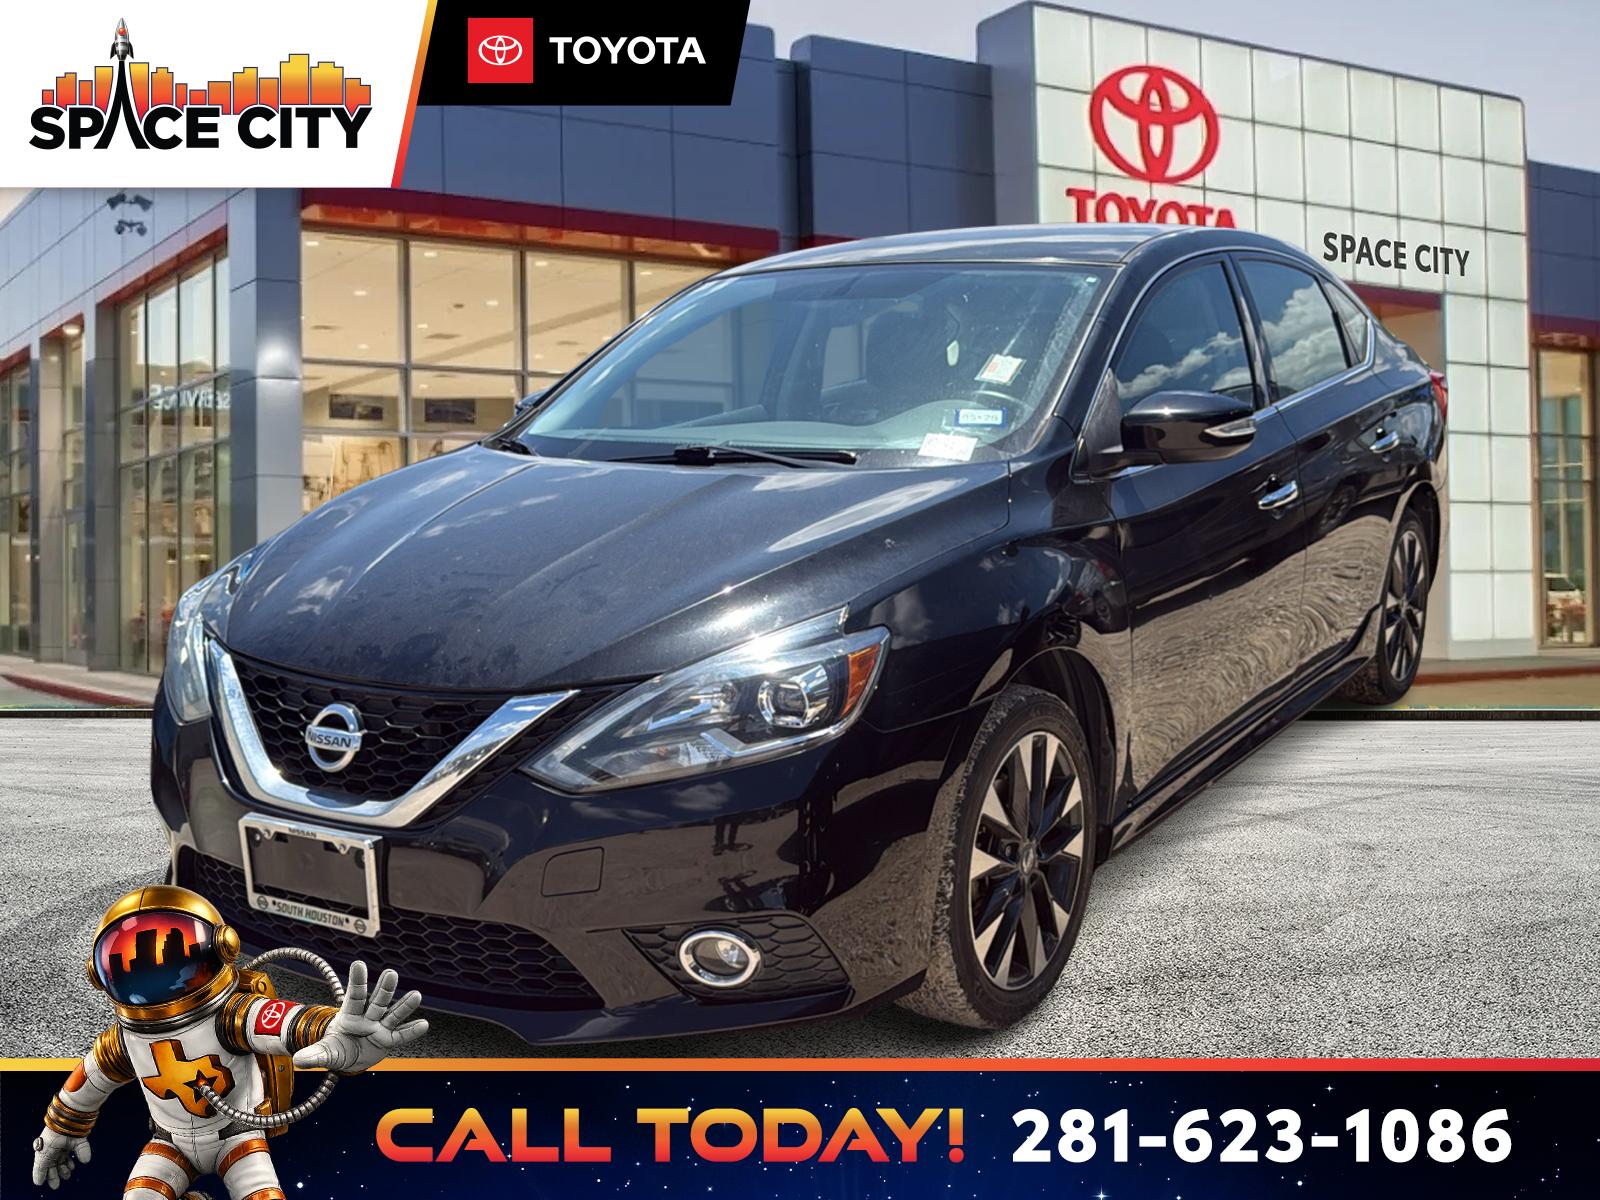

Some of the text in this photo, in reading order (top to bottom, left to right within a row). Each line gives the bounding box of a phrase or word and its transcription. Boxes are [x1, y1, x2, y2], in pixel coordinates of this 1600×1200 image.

[1065, 188, 1237, 228] TOYOTA
[1323, 232, 1470, 276] SPACE CITY
[307, 729, 352, 748] NISSAN
[275, 901, 345, 927] SOUTH HOUSTON
